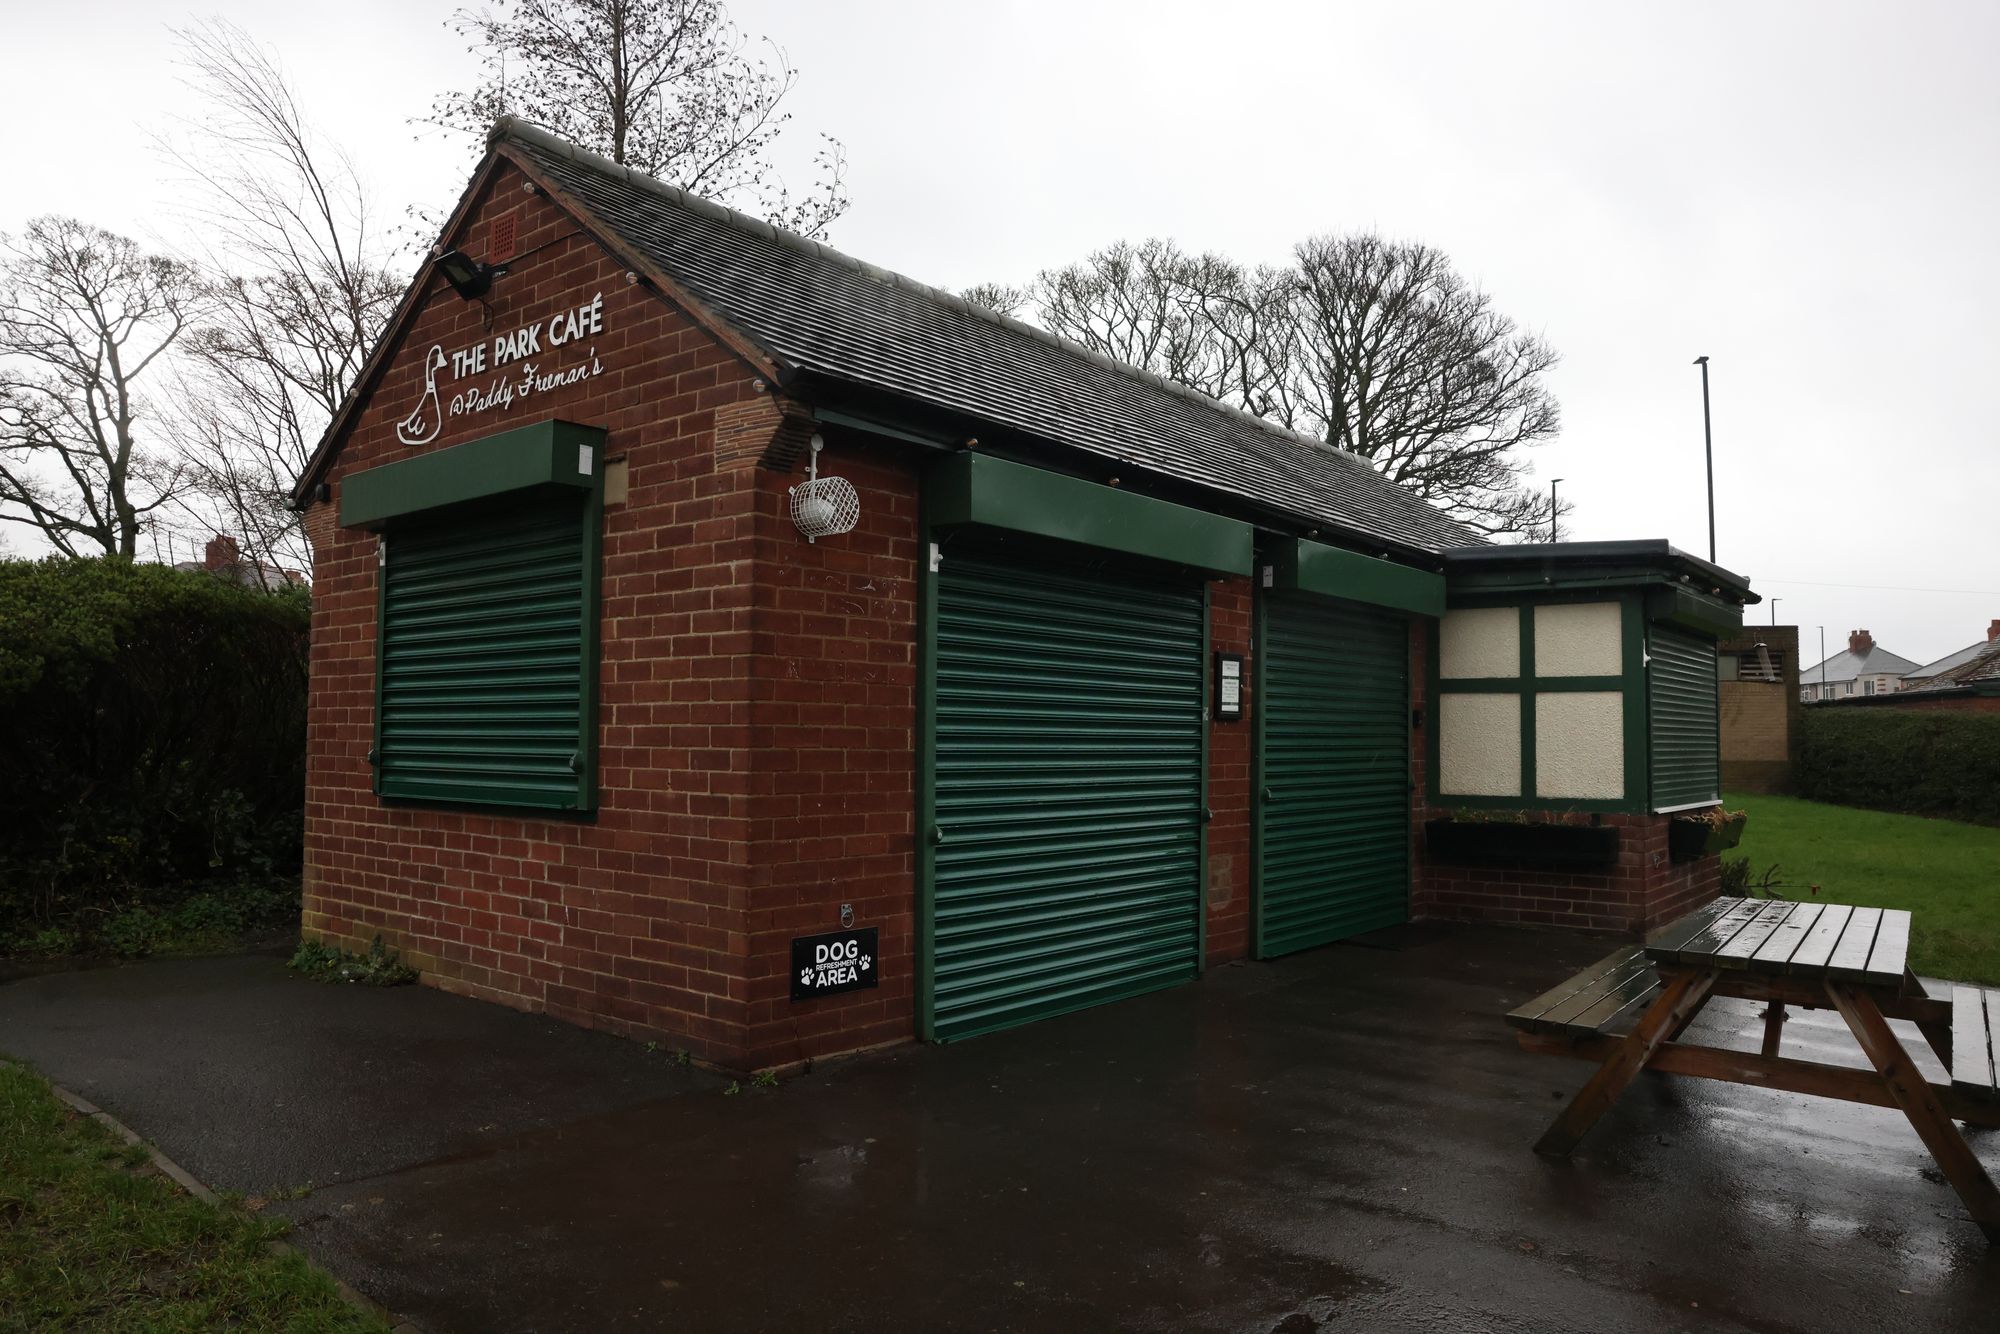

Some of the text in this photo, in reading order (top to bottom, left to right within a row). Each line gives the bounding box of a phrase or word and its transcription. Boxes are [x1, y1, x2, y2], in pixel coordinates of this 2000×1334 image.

[452, 291, 603, 380] THE PARK CAFÉ
[518, 347, 604, 397] Freeman's
[815, 939, 858, 964] DOG
[815, 958, 858, 972] REFRESHMENT
[815, 965, 858, 989] AREA
